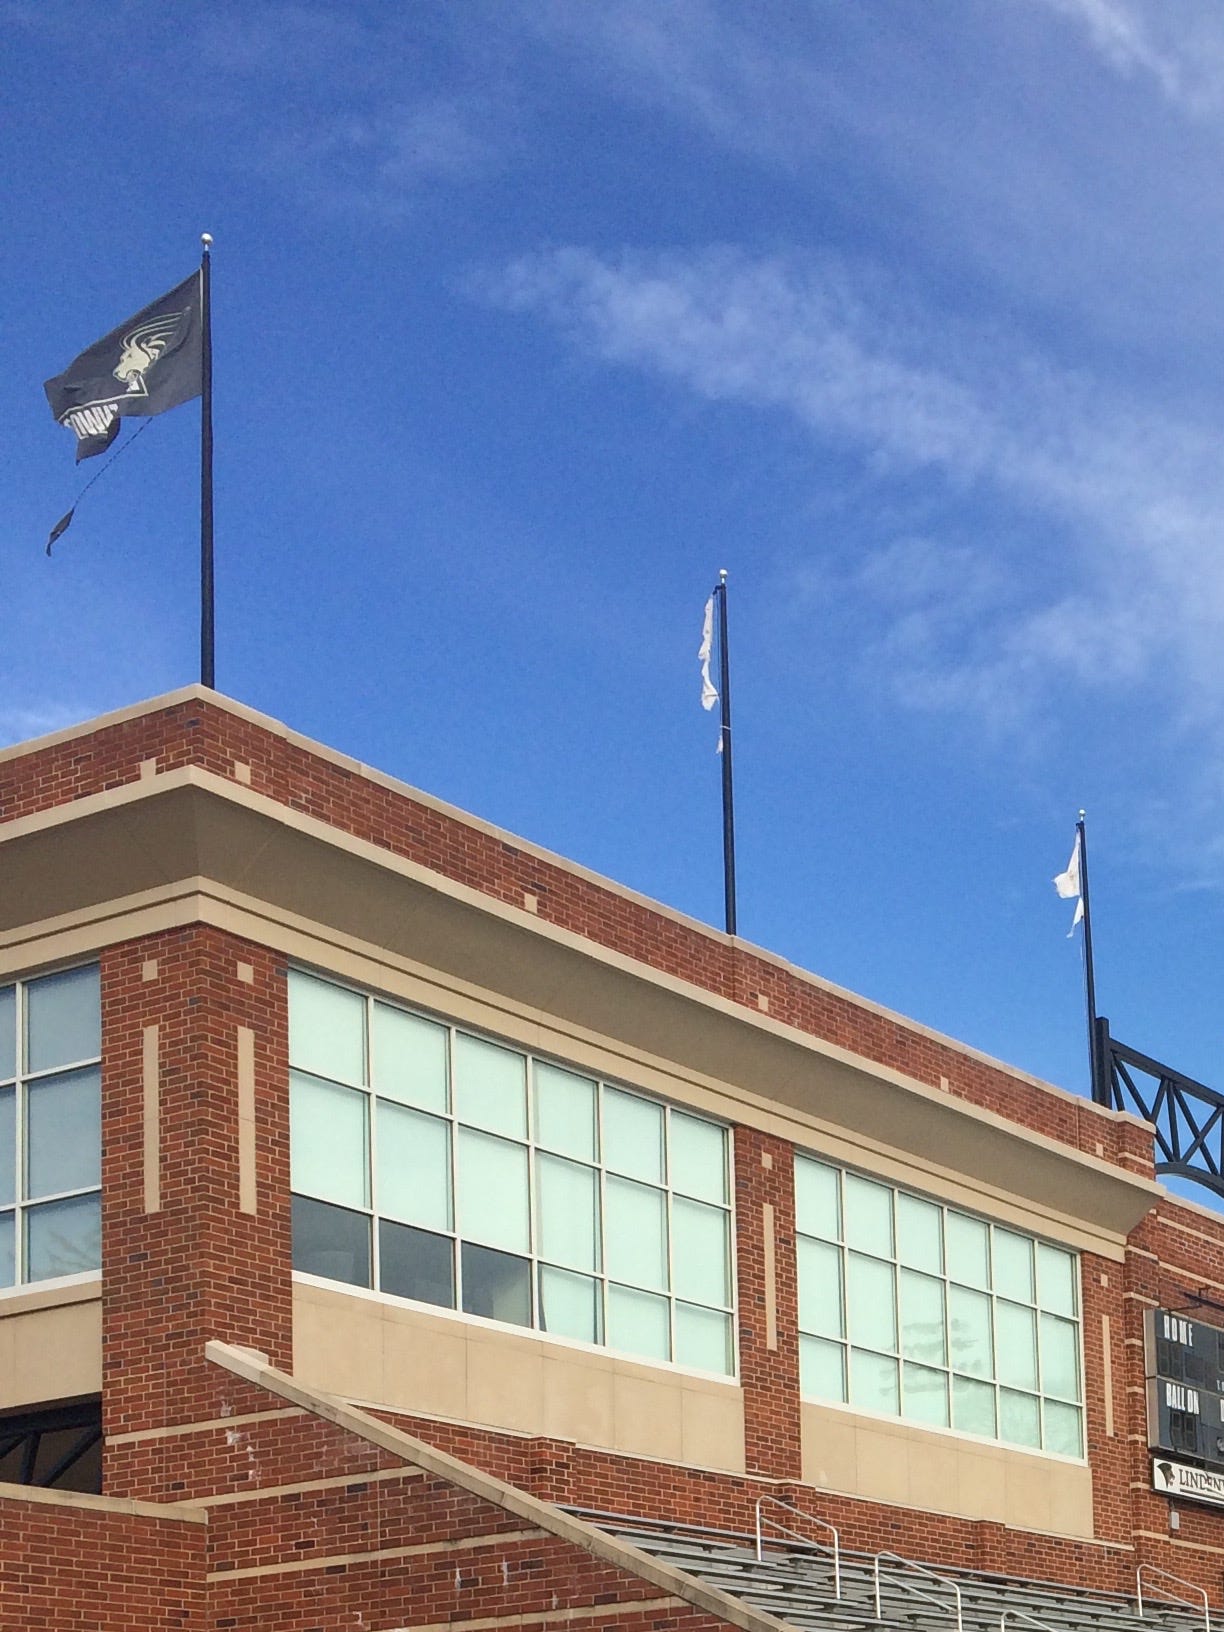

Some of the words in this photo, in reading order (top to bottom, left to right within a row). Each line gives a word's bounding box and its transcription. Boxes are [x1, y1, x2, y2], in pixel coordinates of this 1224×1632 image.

[1163, 1315, 1193, 1347] HOME
[1166, 1382, 1185, 1411] BALL
[1187, 1389, 1199, 1415] ON
